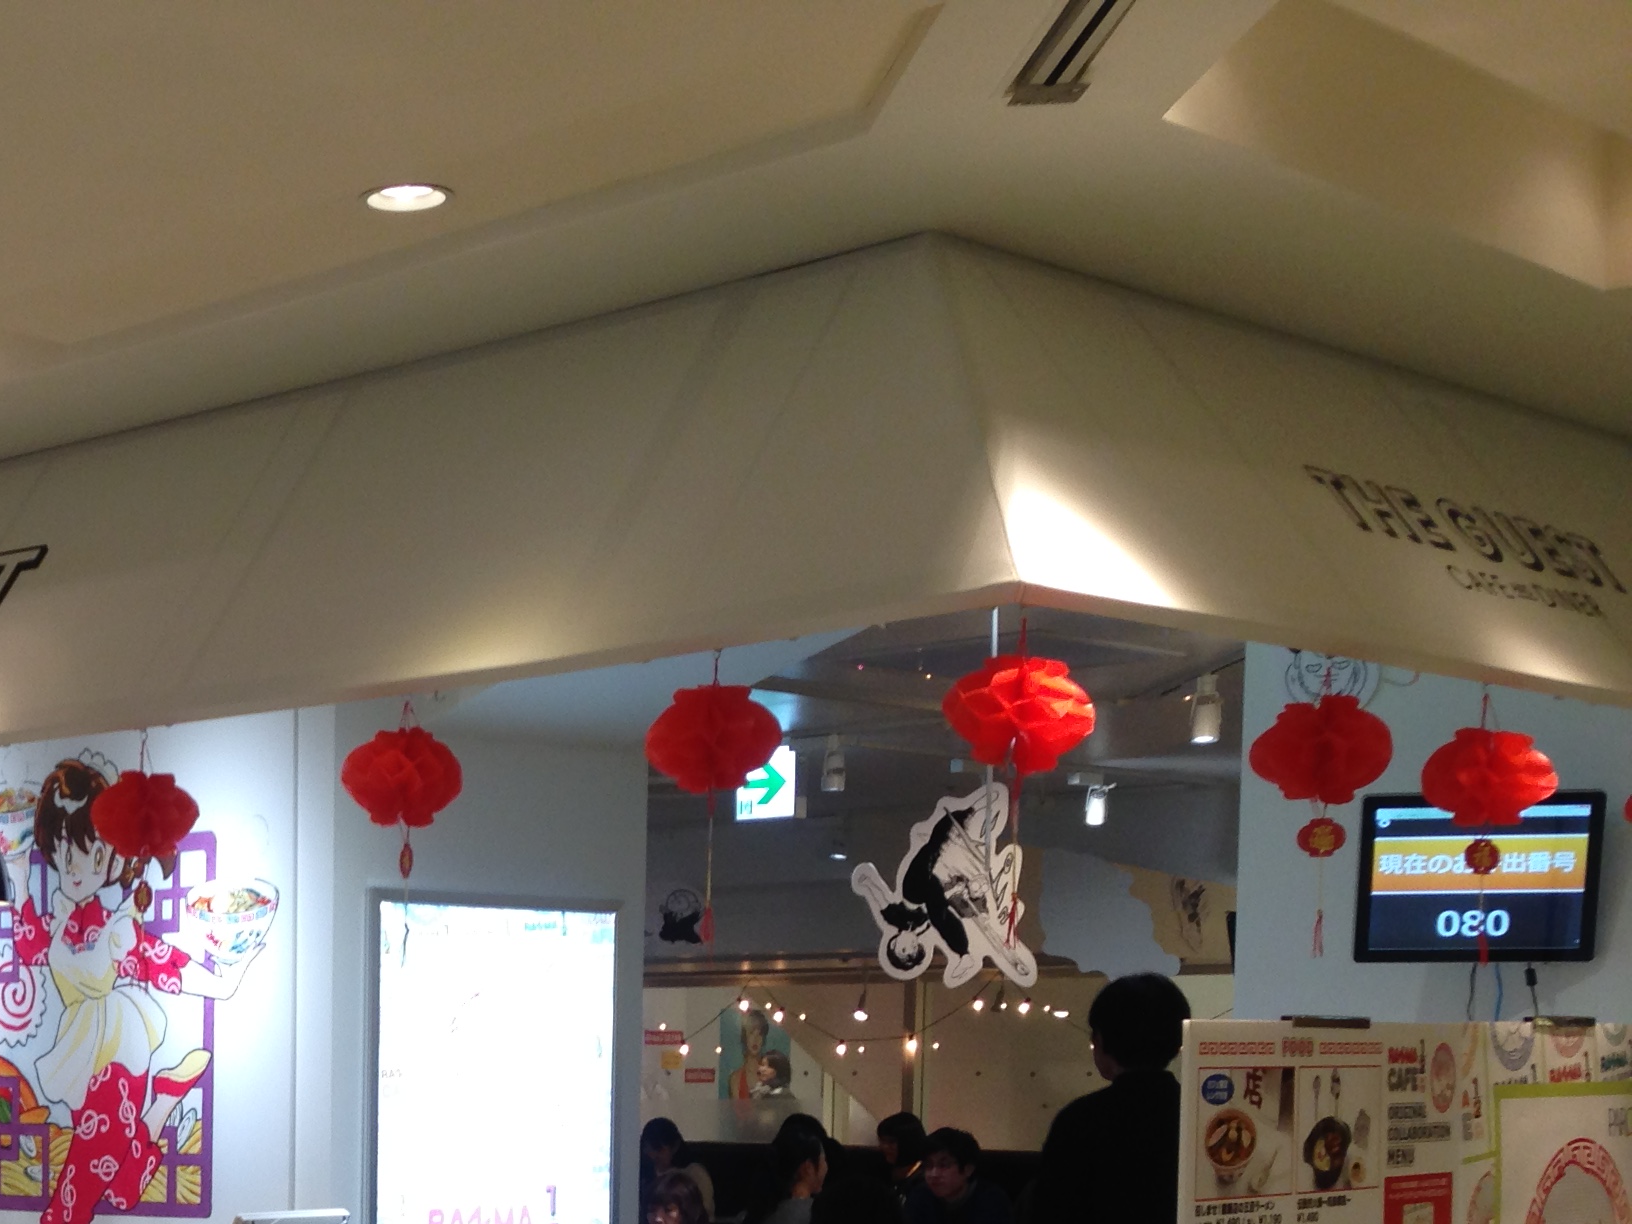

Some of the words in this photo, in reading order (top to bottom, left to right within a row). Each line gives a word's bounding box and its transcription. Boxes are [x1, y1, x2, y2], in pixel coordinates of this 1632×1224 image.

[1303, 464, 1458, 553] THE
[1435, 497, 1628, 594] GUEST
[1445, 564, 1515, 599] CAFE
[1379, 850, 1577, 876] 現在のお出番号
[1436, 909, 1511, 938] 080
[1282, 1036, 1315, 1057] FOOD
